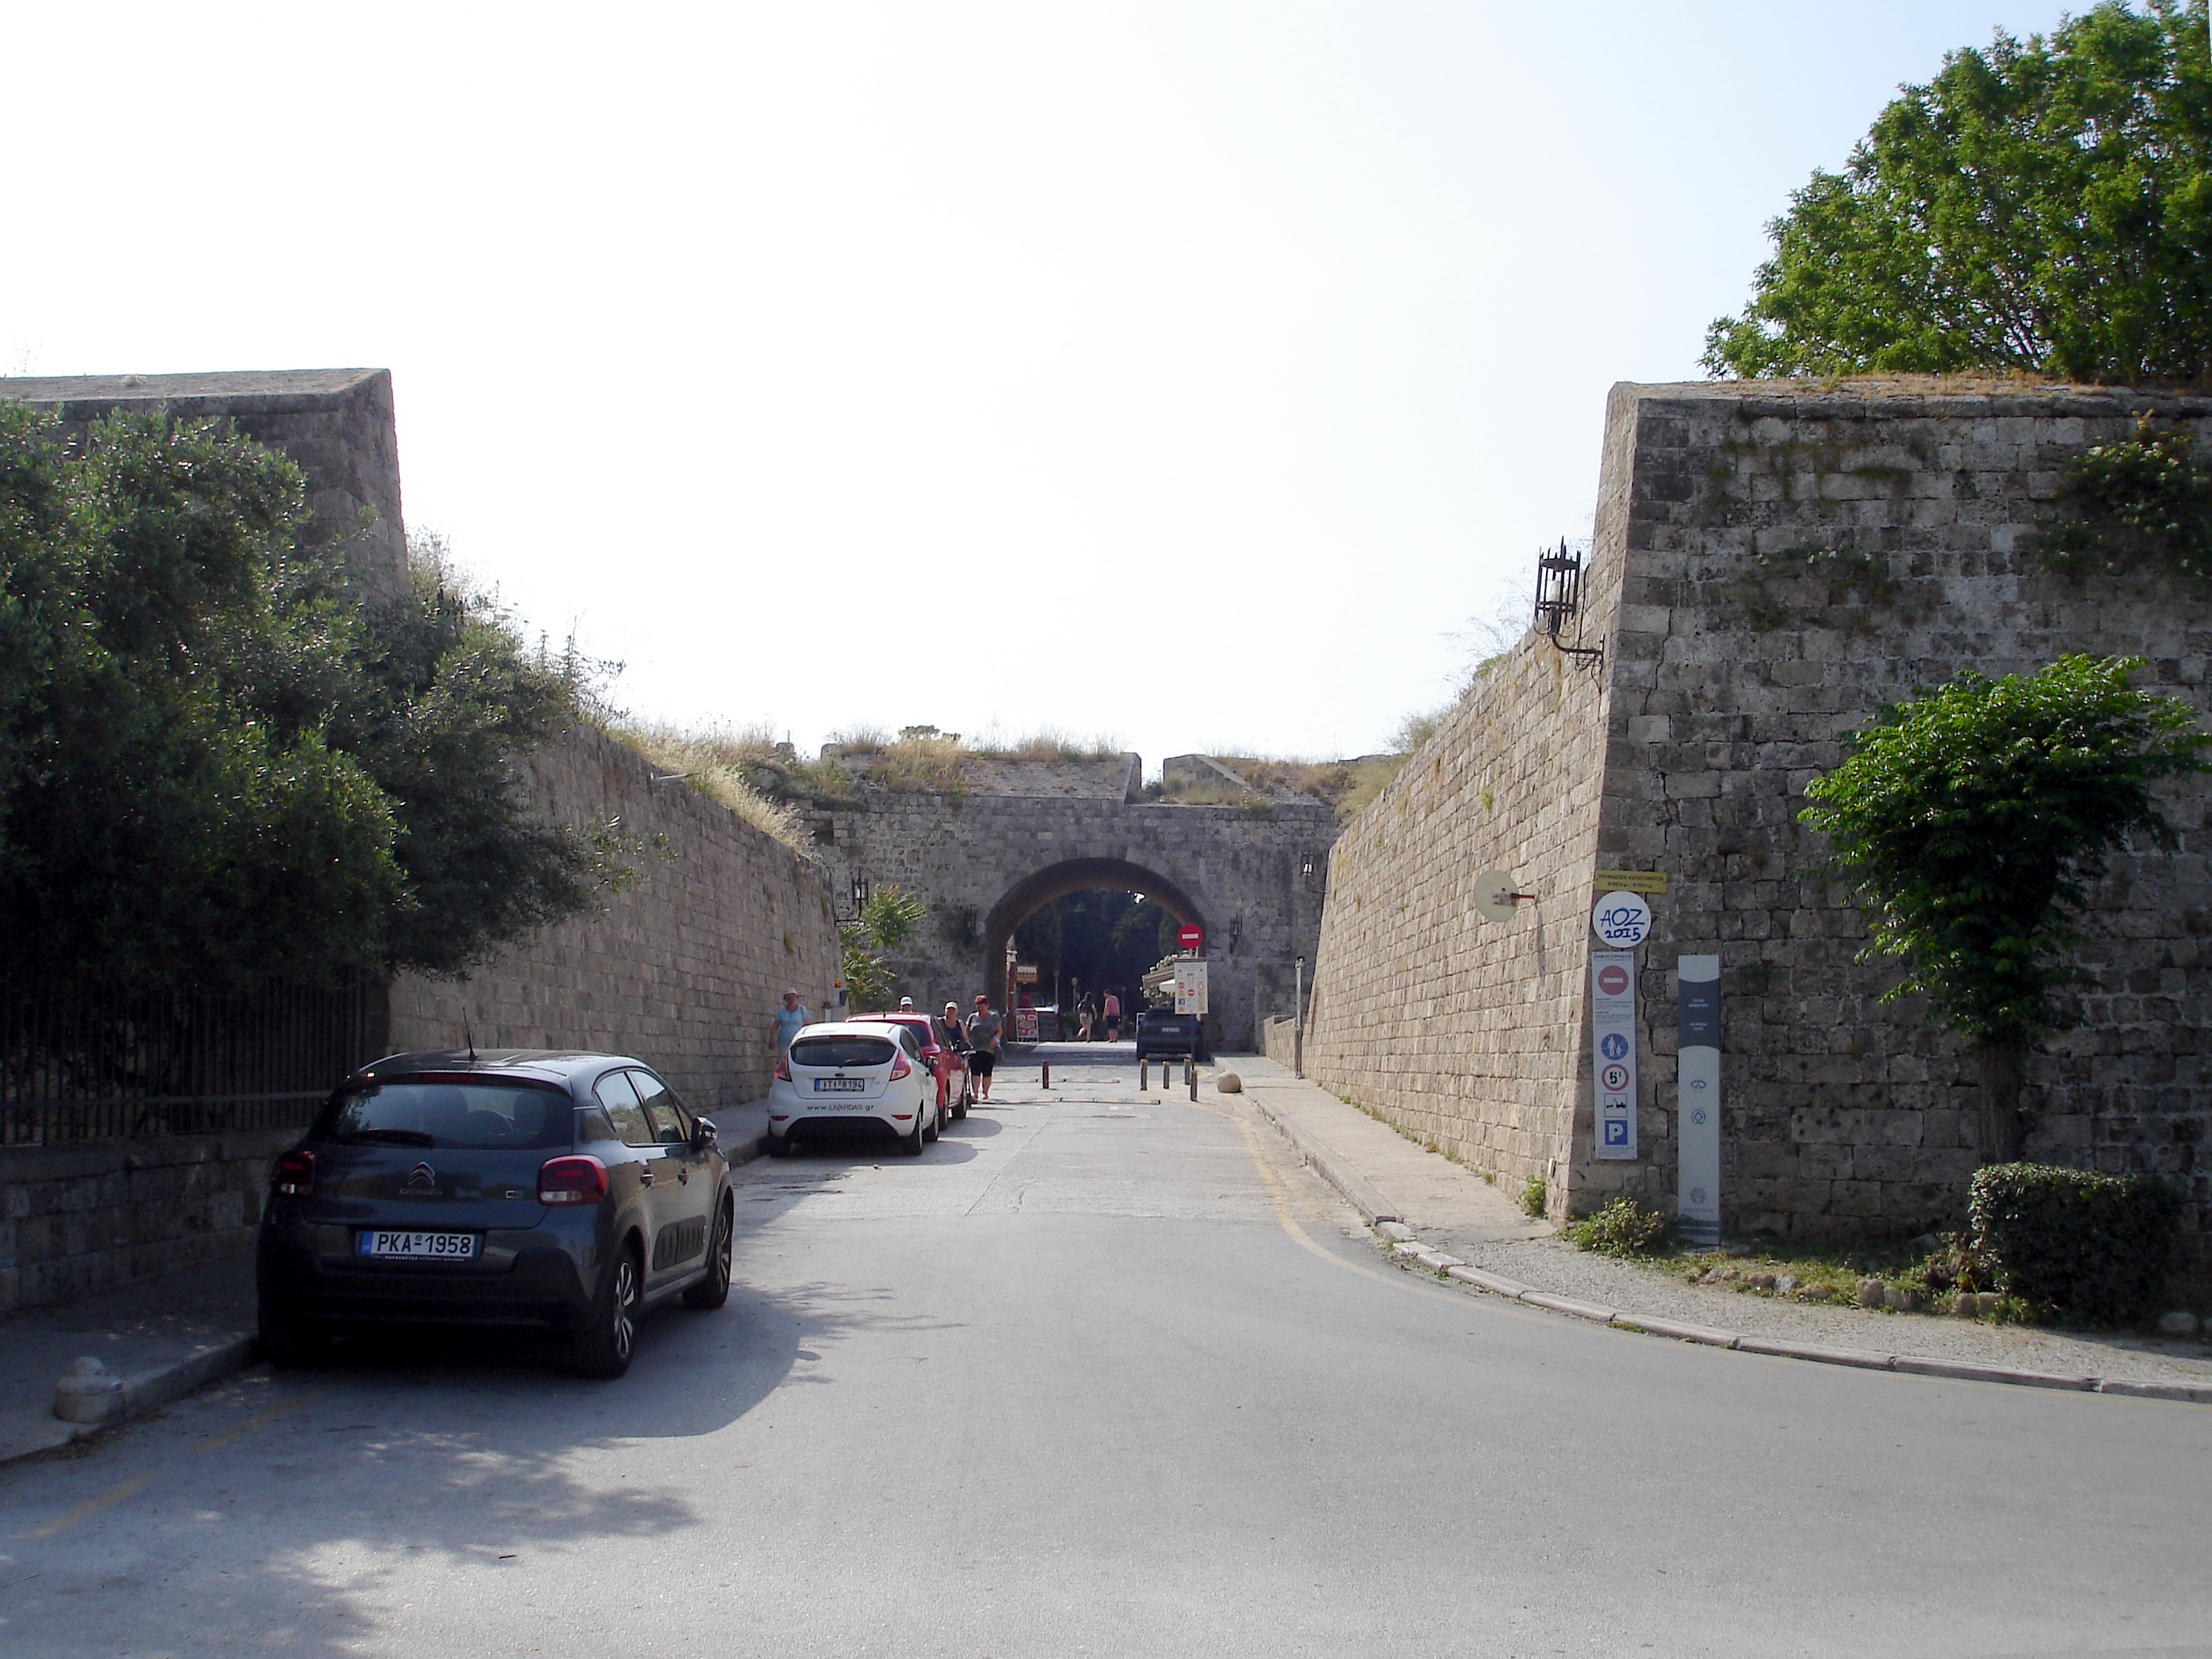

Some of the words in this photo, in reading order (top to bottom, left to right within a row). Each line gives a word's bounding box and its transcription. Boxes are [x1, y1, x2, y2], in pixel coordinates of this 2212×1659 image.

[1600, 908, 1645, 927] AOZ
[1605, 927, 1641, 942] 2015
[1608, 1122, 1623, 1142] P
